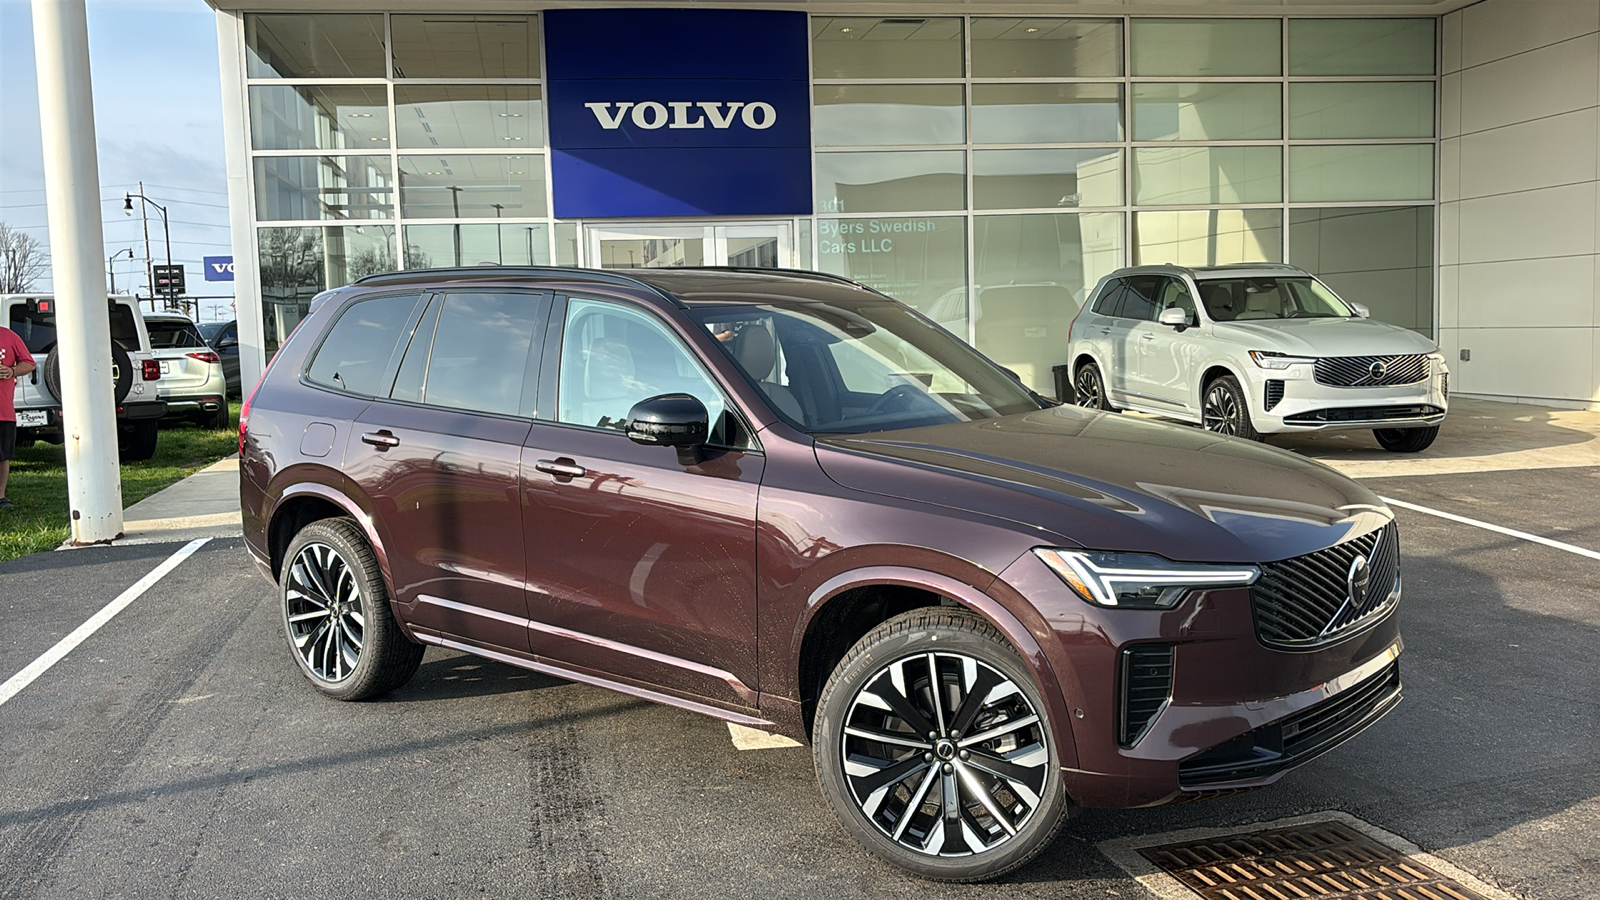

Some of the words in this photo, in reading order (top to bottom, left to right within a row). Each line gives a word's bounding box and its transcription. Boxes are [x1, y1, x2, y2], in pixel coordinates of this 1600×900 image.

[584, 101, 777, 130] VOLVO
[819, 199, 845, 212] 301
[820, 221, 864, 238] Byers
[869, 219, 936, 234] Swedish
[819, 240, 856, 254] Cars
[861, 238, 892, 253] LLC
